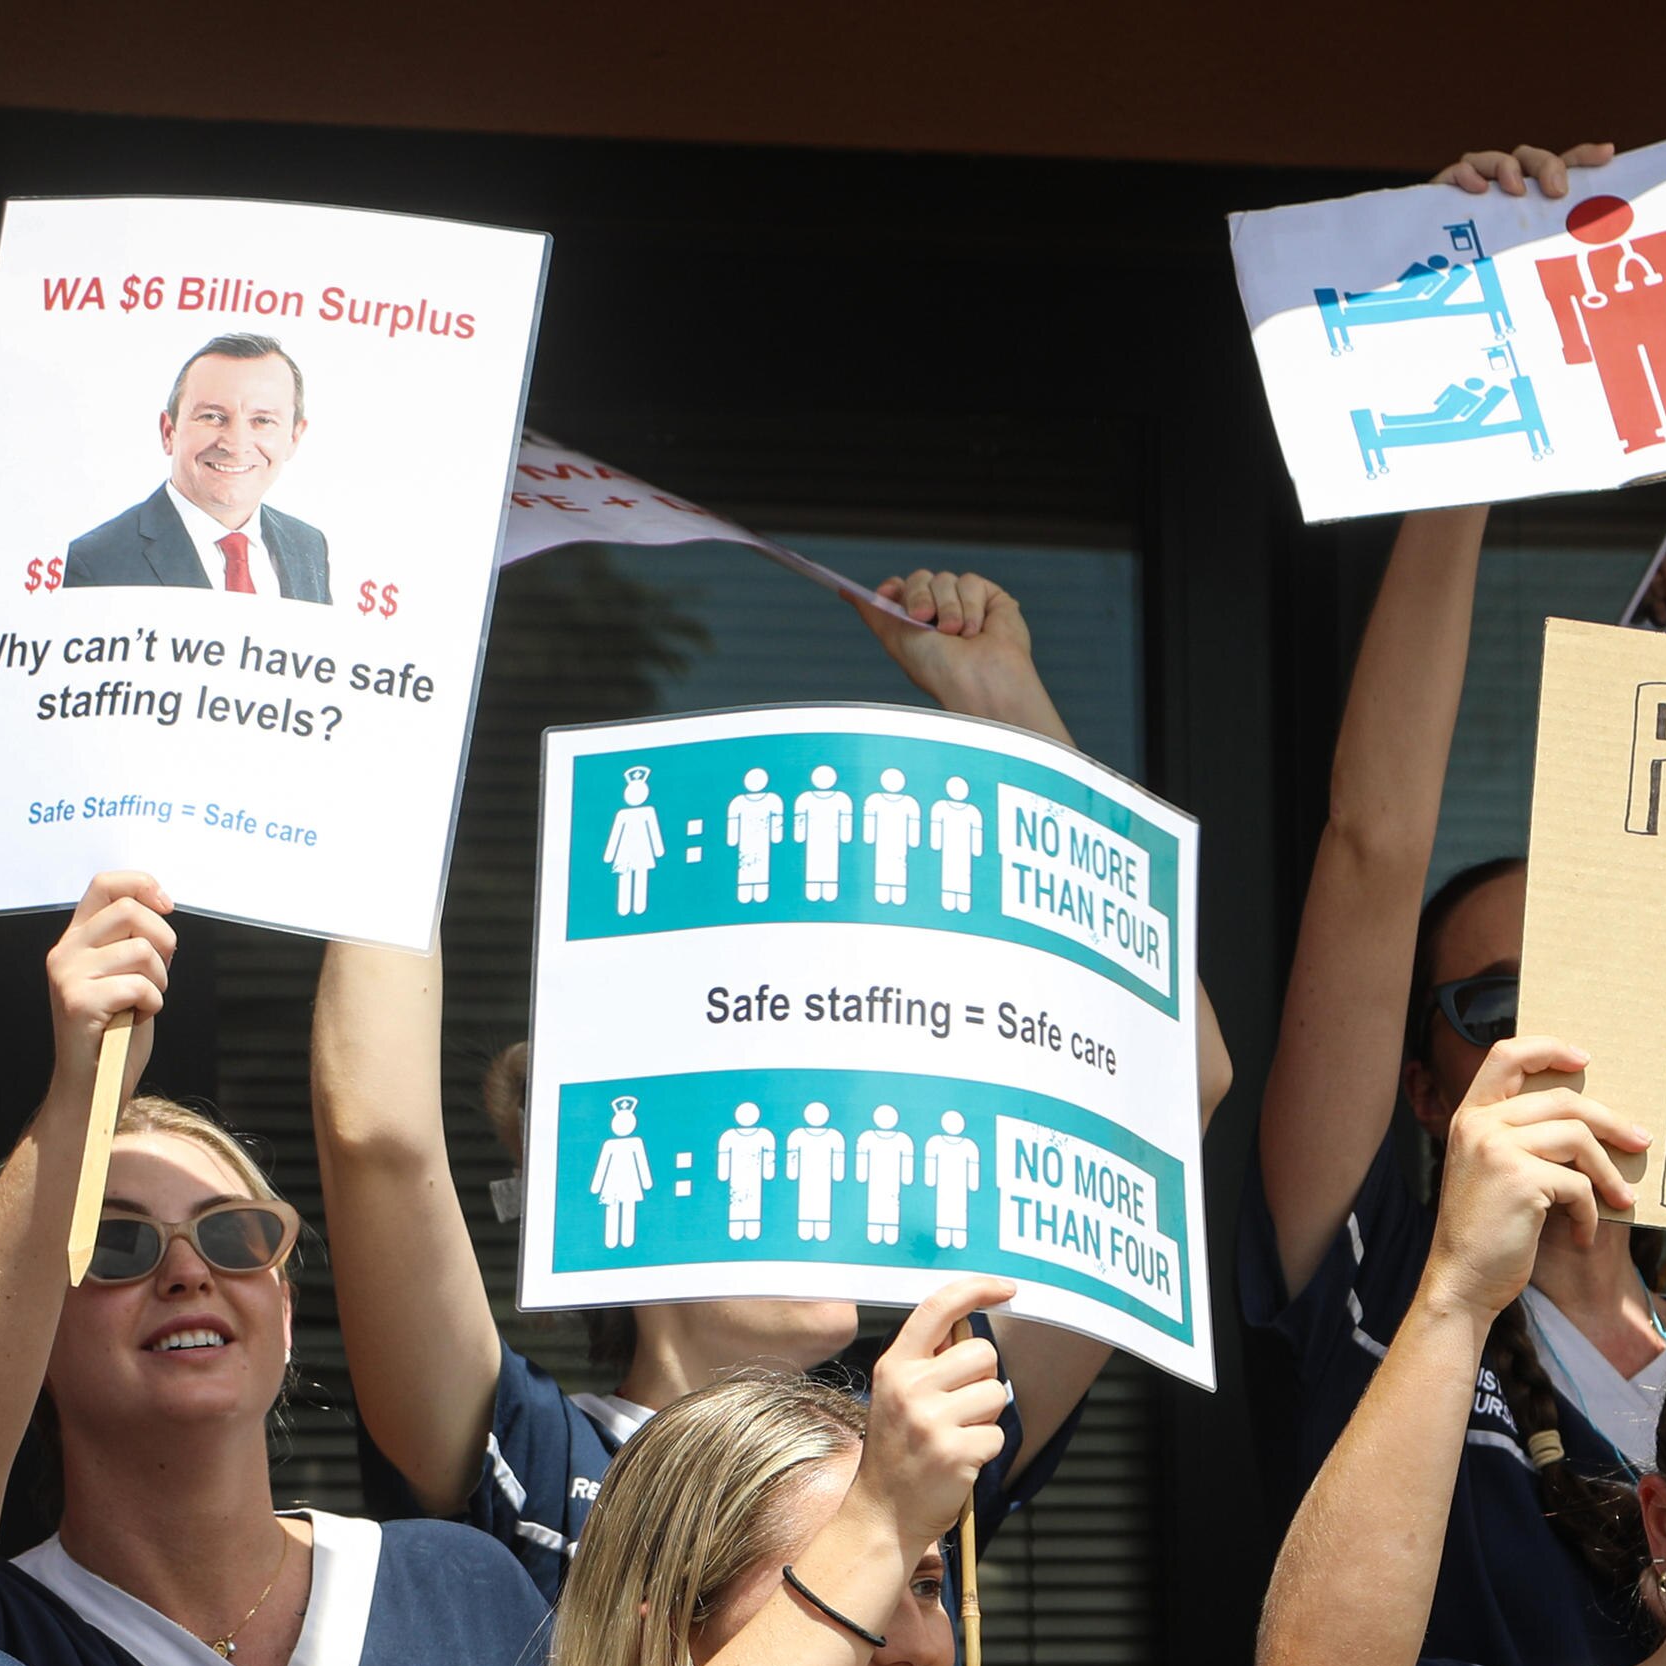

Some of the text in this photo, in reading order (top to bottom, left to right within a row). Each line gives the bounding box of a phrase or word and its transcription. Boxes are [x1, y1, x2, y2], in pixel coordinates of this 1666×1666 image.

[41, 273, 477, 341] WA $6 Billion Surplus
[62, 628, 158, 665] can't
[171, 637, 226, 667] we
[240, 636, 336, 685] have
[349, 659, 435, 704] safe
[36, 680, 344, 742] staffing levels?
[27, 800, 76, 826] Safe
[82, 795, 174, 824] Staffing
[203, 805, 258, 836] Safe
[265, 822, 319, 849] care
[1015, 807, 1138, 900] NO MORE
[1010, 862, 1161, 971] THAN FOUR
[705, 984, 791, 1025] Safe
[804, 986, 951, 1038] staffing
[997, 1002, 1062, 1057] Safe
[1070, 1030, 1117, 1076] care
[1014, 1138, 1145, 1226] NO MORE
[1010, 1195, 1171, 1297] THAN FOUR
